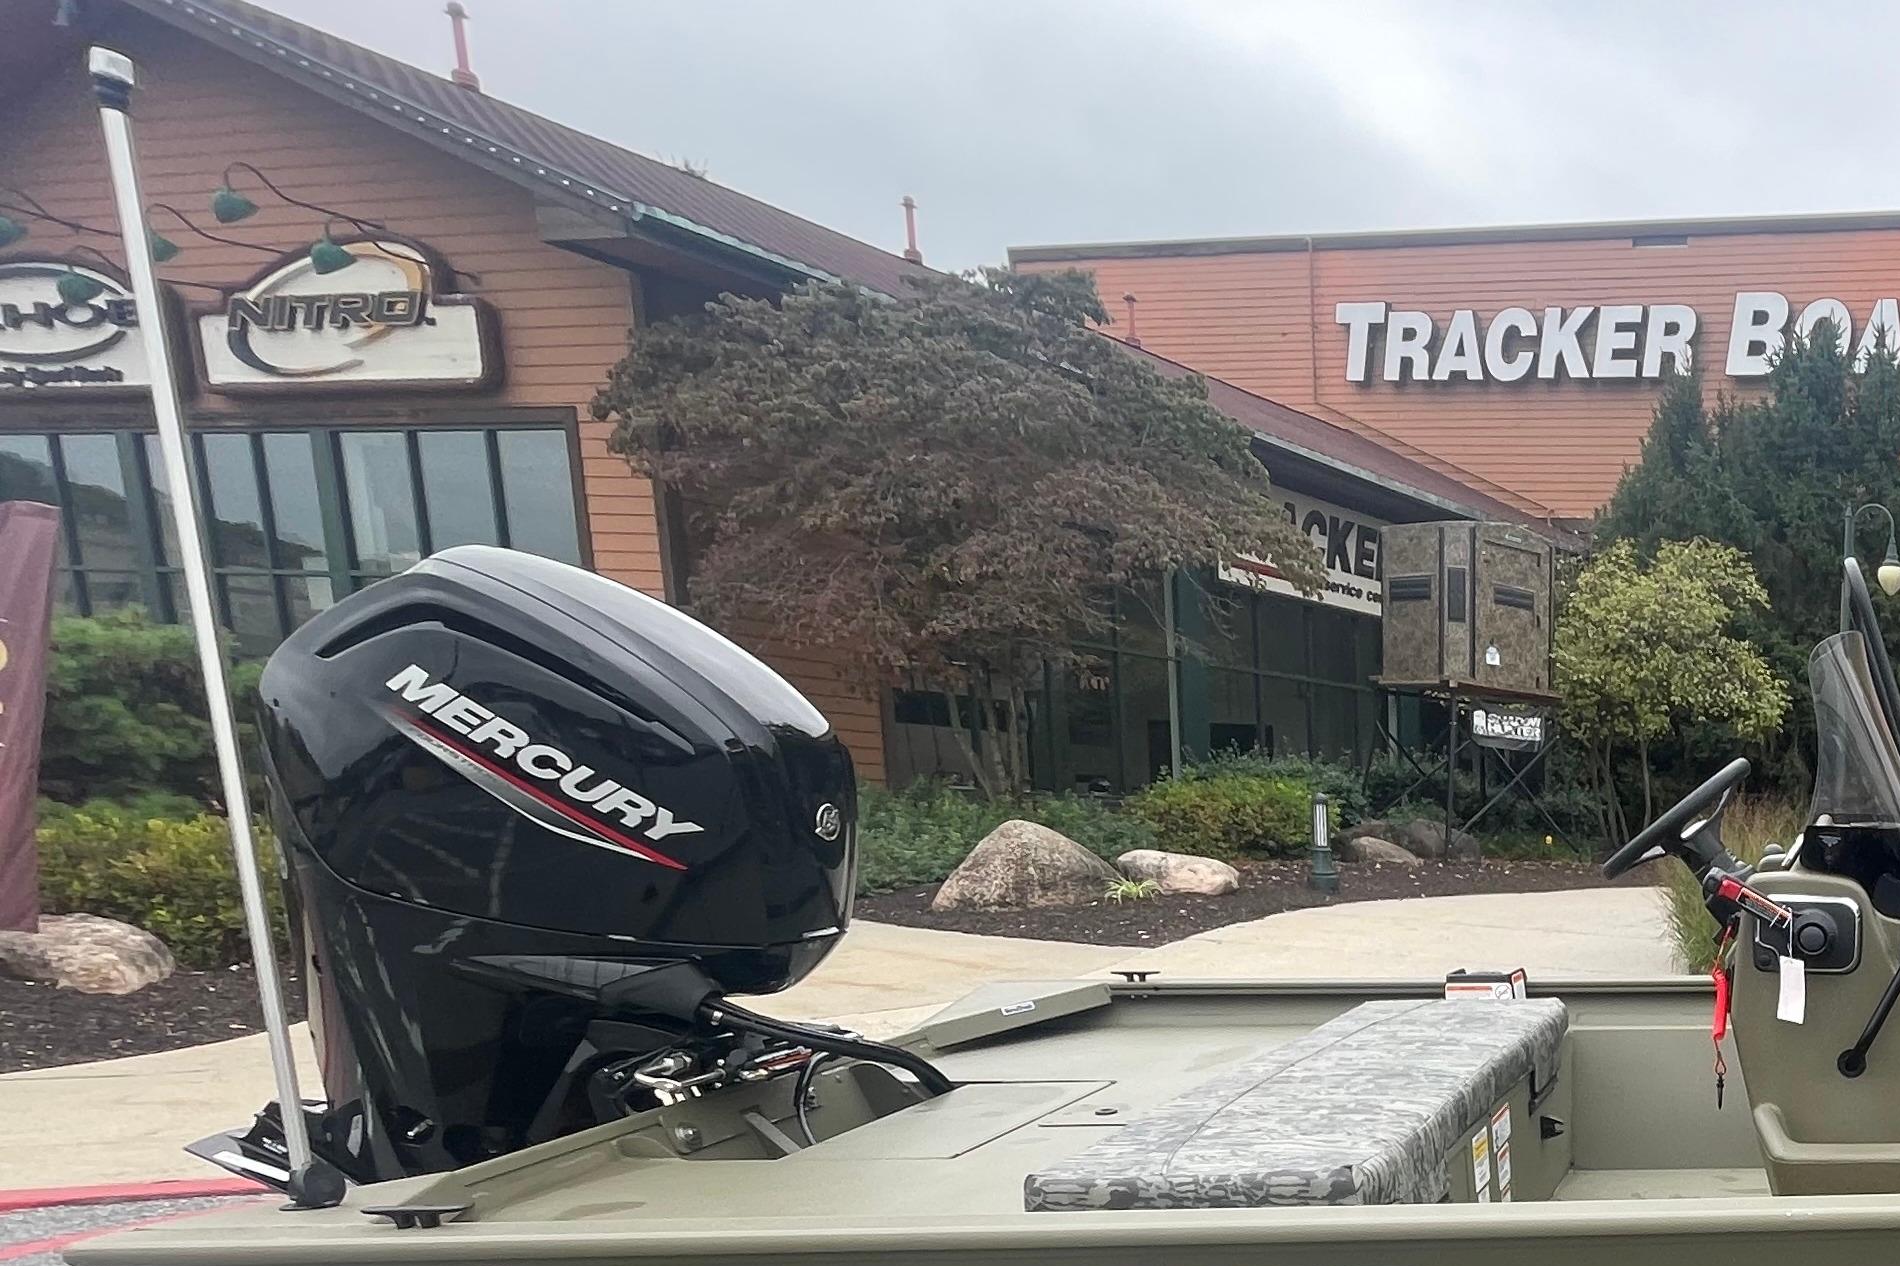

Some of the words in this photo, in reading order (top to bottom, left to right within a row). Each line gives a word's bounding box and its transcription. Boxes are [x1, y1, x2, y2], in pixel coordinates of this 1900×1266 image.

[228, 291, 423, 331] NITRO
[1335, 302, 1697, 382] TRACKER
[386, 664, 704, 840] MERCURY
